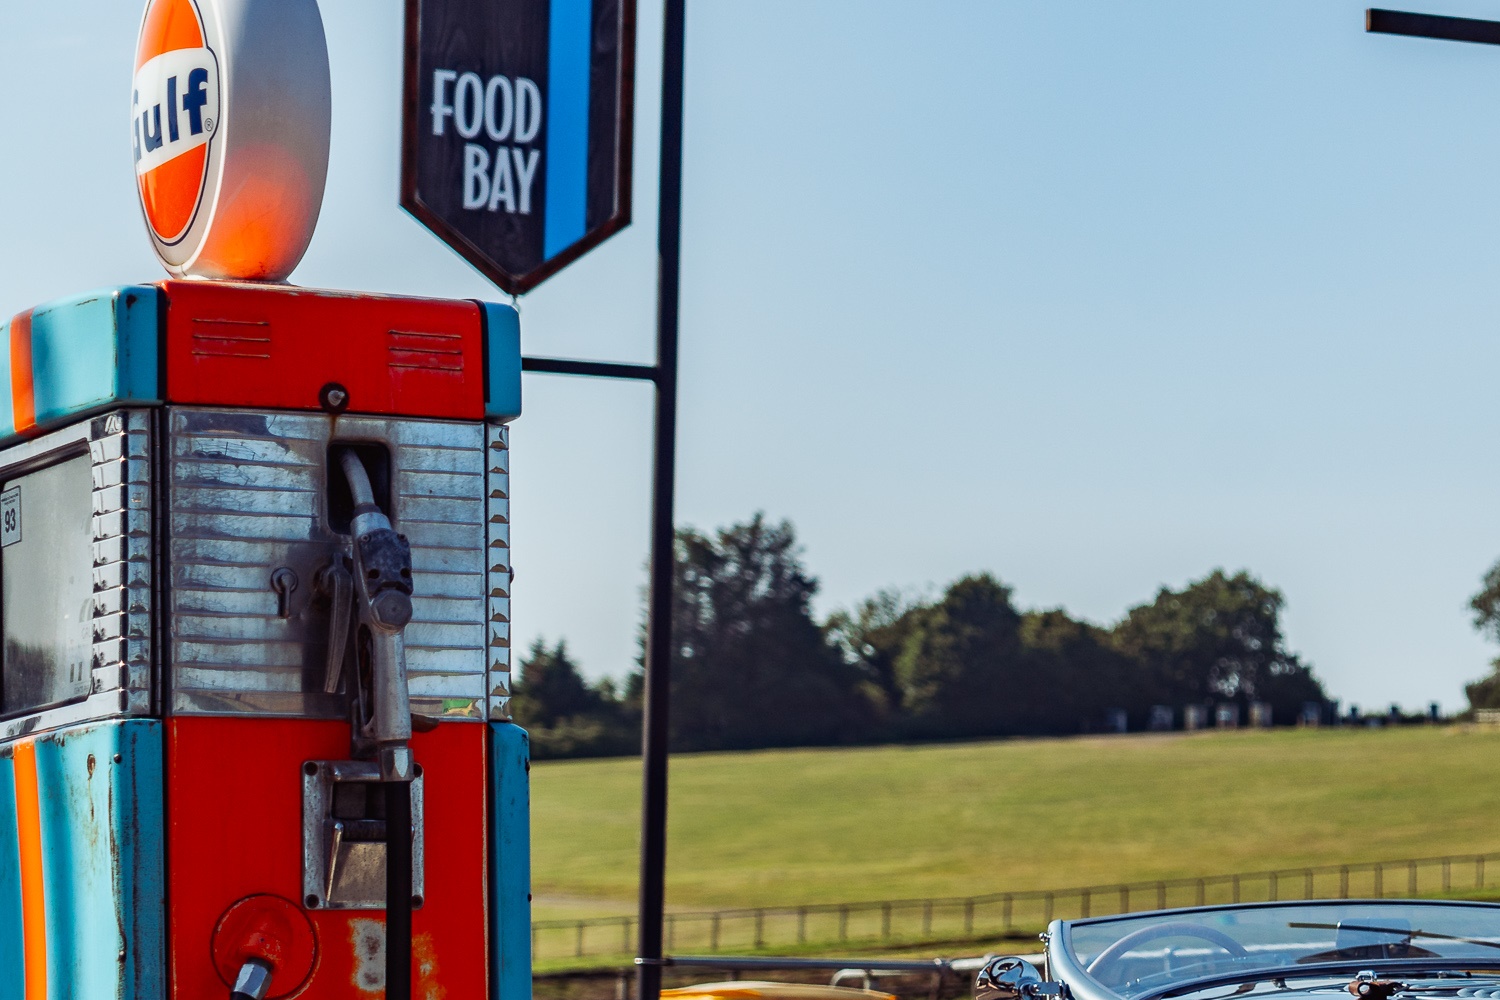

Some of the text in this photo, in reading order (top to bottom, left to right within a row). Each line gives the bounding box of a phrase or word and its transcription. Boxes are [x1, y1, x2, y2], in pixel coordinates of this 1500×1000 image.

[430, 69, 541, 143] FOOD
[463, 143, 540, 215] BAY
[5, 508, 16, 533] 93
